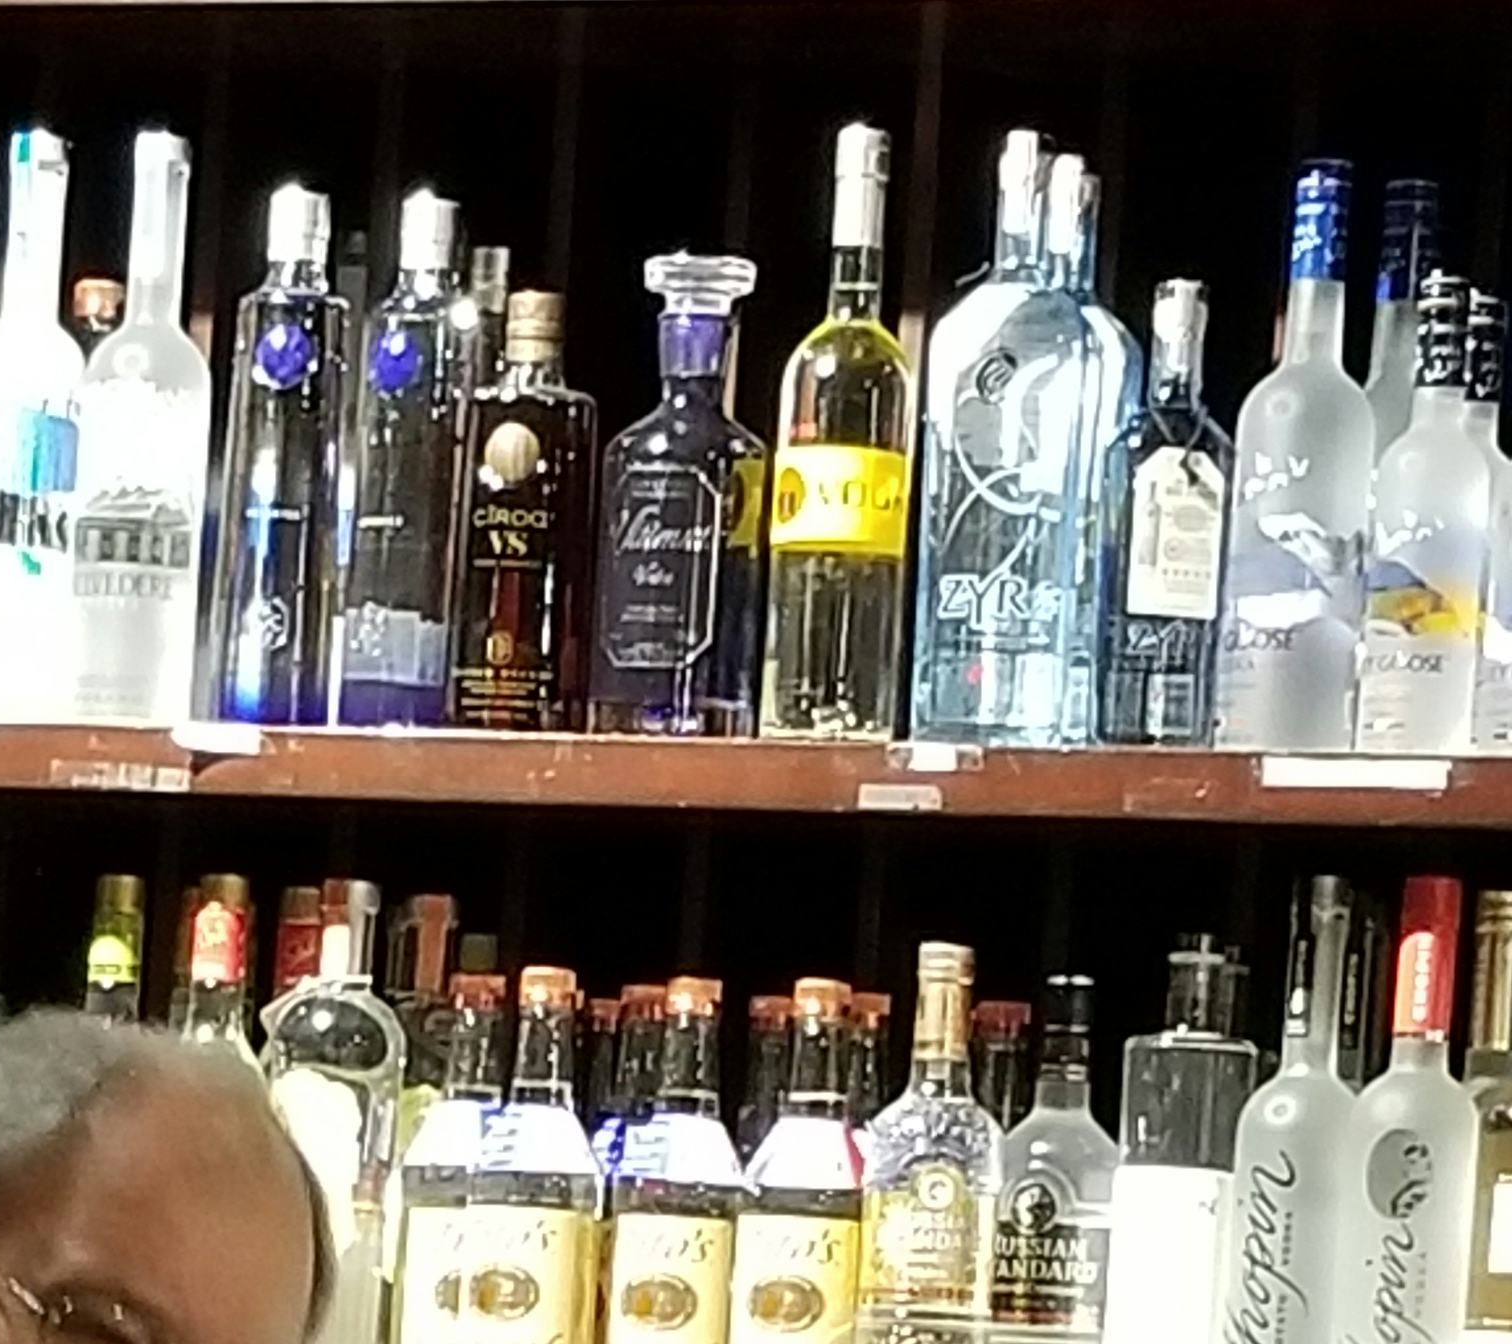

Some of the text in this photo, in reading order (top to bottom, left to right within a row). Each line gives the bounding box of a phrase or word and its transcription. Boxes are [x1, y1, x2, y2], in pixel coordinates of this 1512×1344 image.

[488, 529, 528, 556] VS
[937, 572, 1032, 632] ZYR
[993, 1258, 1099, 1285] ANDARD
